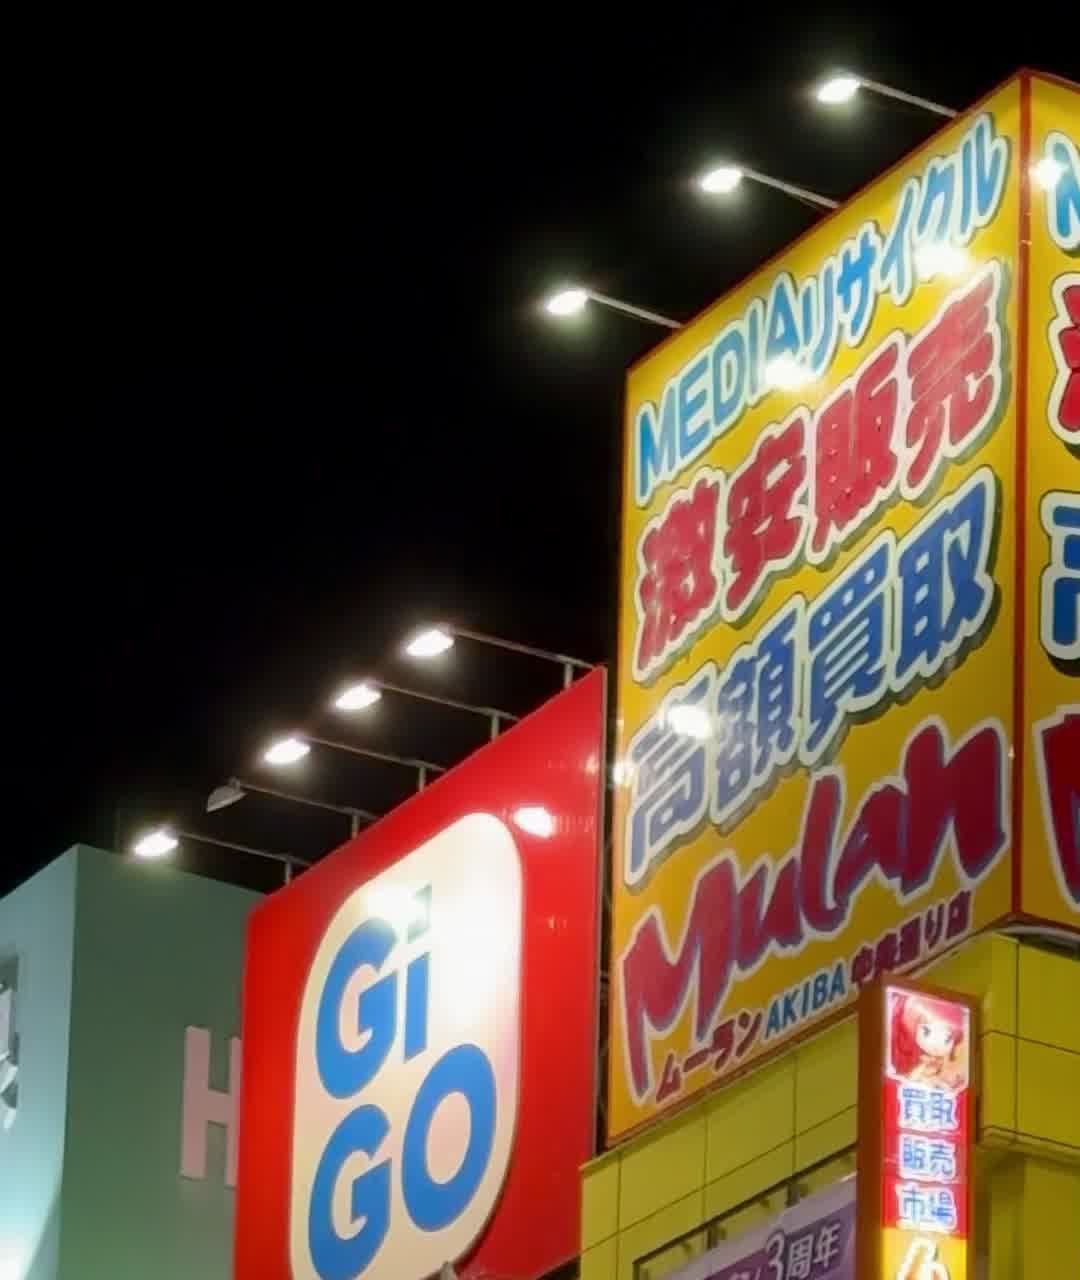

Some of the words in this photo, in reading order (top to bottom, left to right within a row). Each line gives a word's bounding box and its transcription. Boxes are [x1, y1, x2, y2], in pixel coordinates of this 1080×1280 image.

[638, 118, 1002, 502] MEDIAリサイクル
[638, 272, 994, 672] 激安販売
[630, 476, 992, 876] 高額買取
[622, 722, 1006, 1098] Mulan
[656, 1010, 762, 1098] ムーラン
[764, 965, 846, 1040] AKIBA
